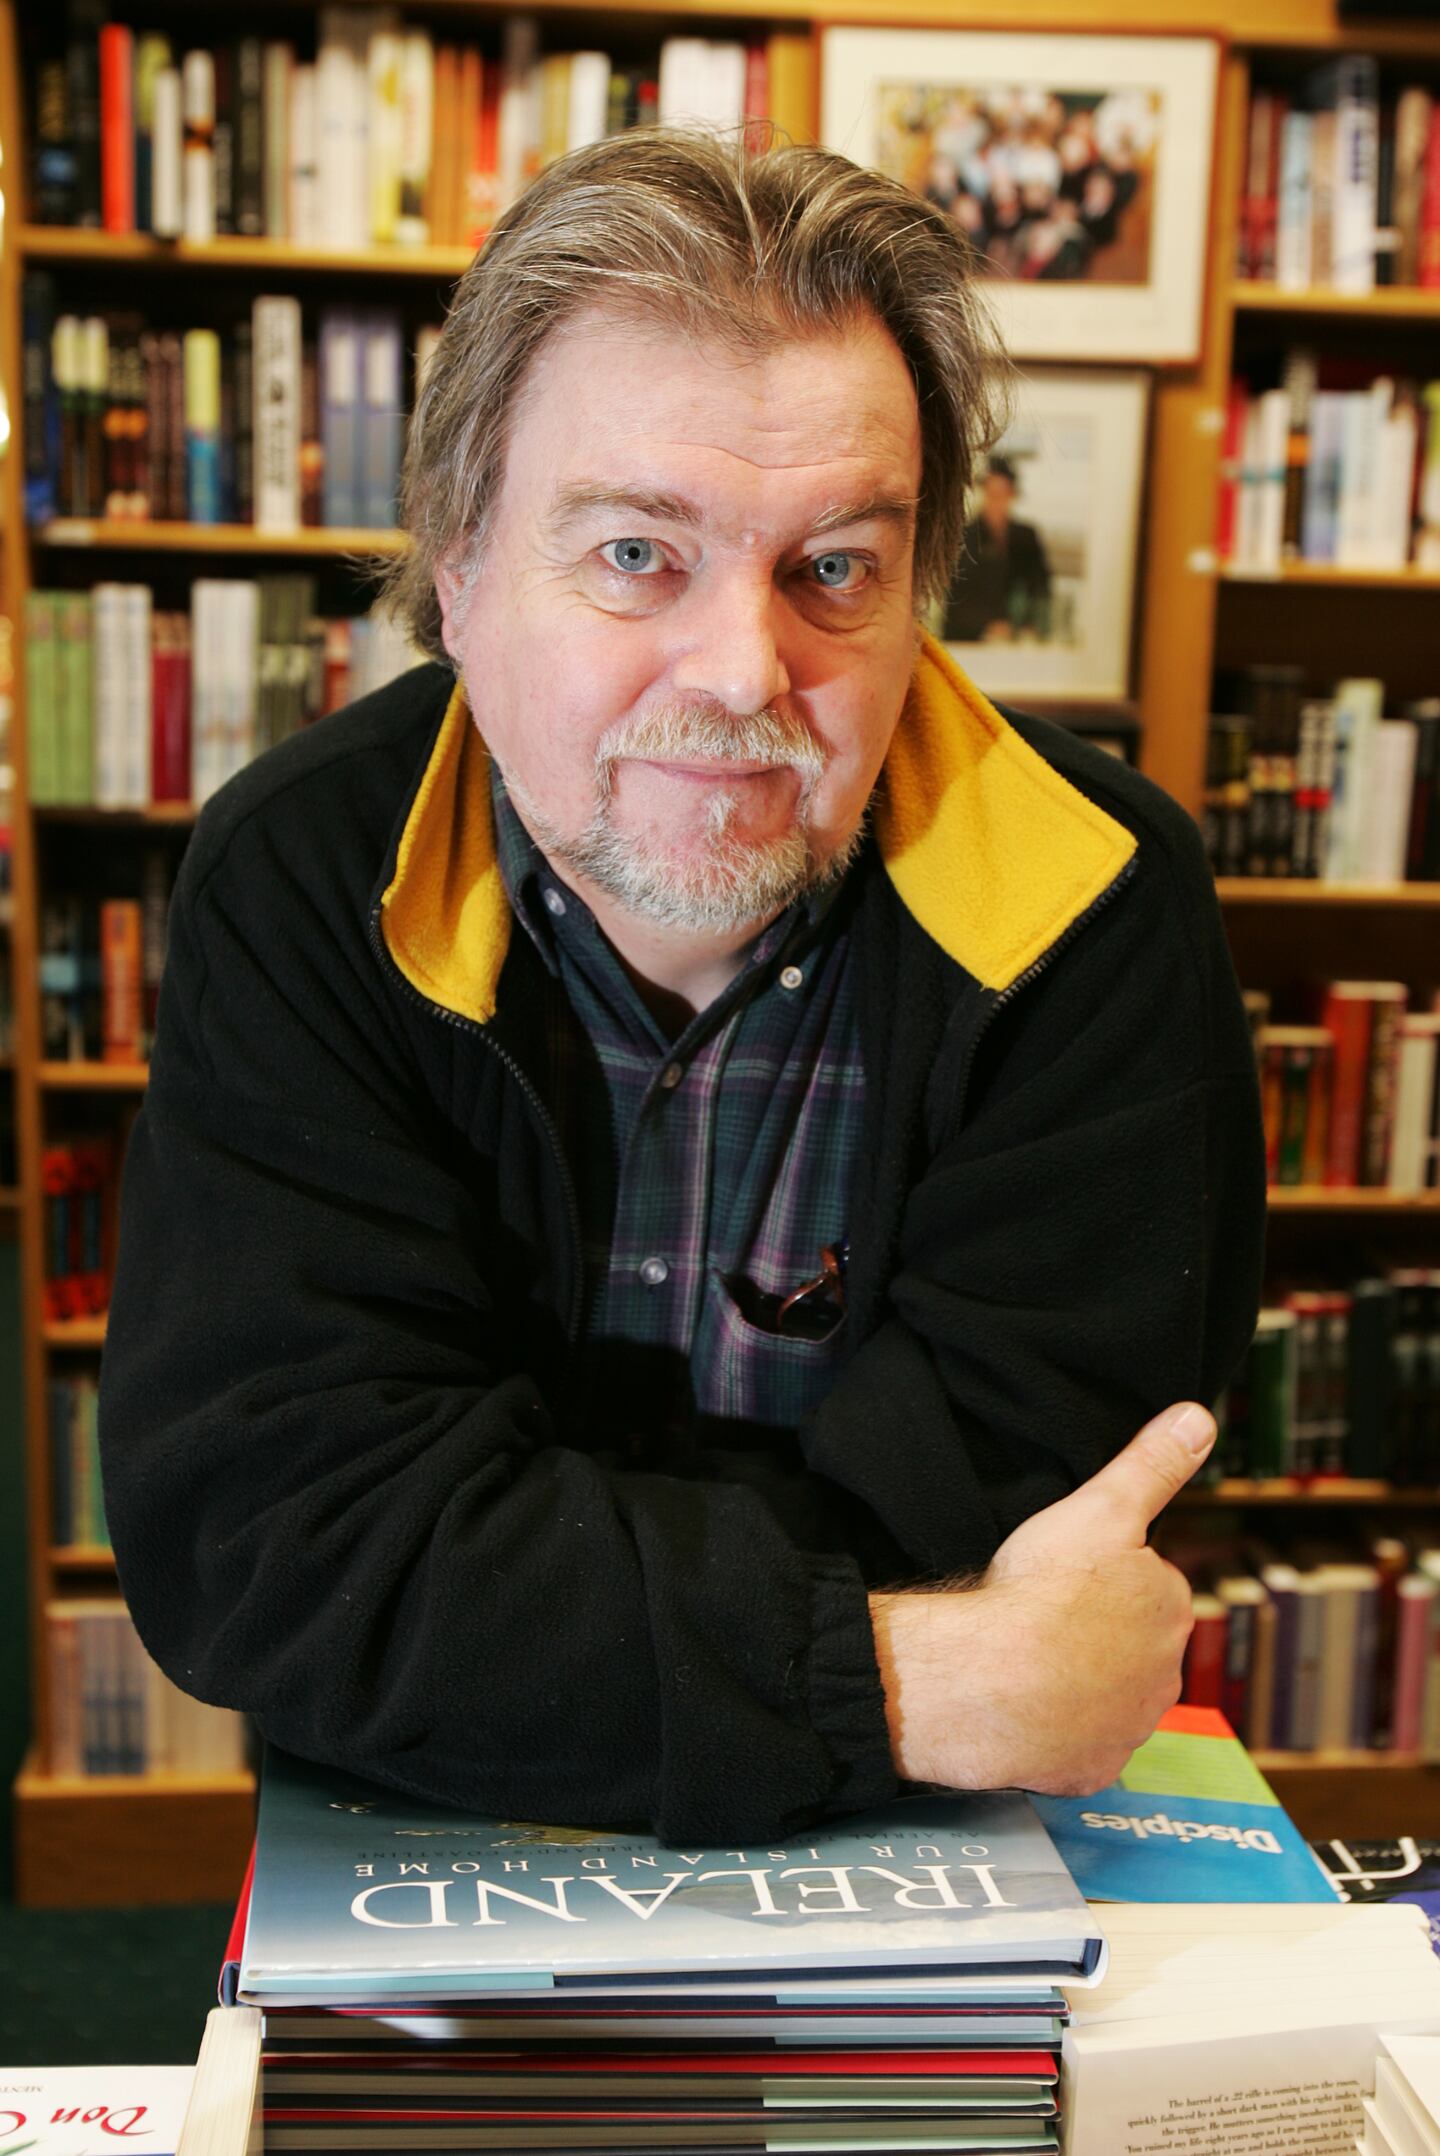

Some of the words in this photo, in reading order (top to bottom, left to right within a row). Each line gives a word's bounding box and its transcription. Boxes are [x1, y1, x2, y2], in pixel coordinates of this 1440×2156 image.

[1081, 1812, 1283, 1854] Disciples
[357, 1850, 498, 1860] COASTLINE
[513, 1845, 644, 1856] IRELAND'S
[581, 1848, 821, 1870] ISLAND
[870, 1845, 989, 1858] OUR
[354, 1860, 529, 1877] HOME
[350, 1864, 1017, 1929] IRELAND
[1169, 2099, 1183, 2108] The
[1187, 2096, 1211, 2106] barrel
[1214, 2094, 1221, 2102] of
[1246, 2090, 1260, 2098] rifle
[1273, 2085, 1300, 2095] coming
[1321, 2080, 1333, 2088] the
[50, 2106, 155, 2137] Don
[1128, 2115, 1157, 2128] quickly
[1161, 2111, 1195, 2122] followed
[1198, 2109, 1206, 2120] by
[1217, 2106, 1236, 2115] short
[1240, 2103, 1257, 2112] dark
[1281, 2098, 1297, 2106] with
[1313, 2094, 1332, 2104] right
[1336, 2090, 1356, 2099] index
[1162, 2126, 1174, 2136] the
[1223, 2119, 1253, 2127] mutters
[1256, 2112, 1296, 2124] something
[1299, 2107, 1341, 2117] incoherent
[1145, 2141, 1171, 2151] ruined
[1175, 2141, 1185, 2150] my
[1190, 2137, 1202, 2146] life
[1206, 2135, 1224, 2145] eight
[1228, 2133, 1248, 2143] years
[1297, 2123, 1318, 2133] going
[1249, 2143, 1263, 2151] and
[1266, 2139, 1285, 2148] holds
[1288, 2137, 1300, 2145] the
[1304, 2134, 1330, 2142] muzzle
[1315, 2145, 1348, 2154] between
